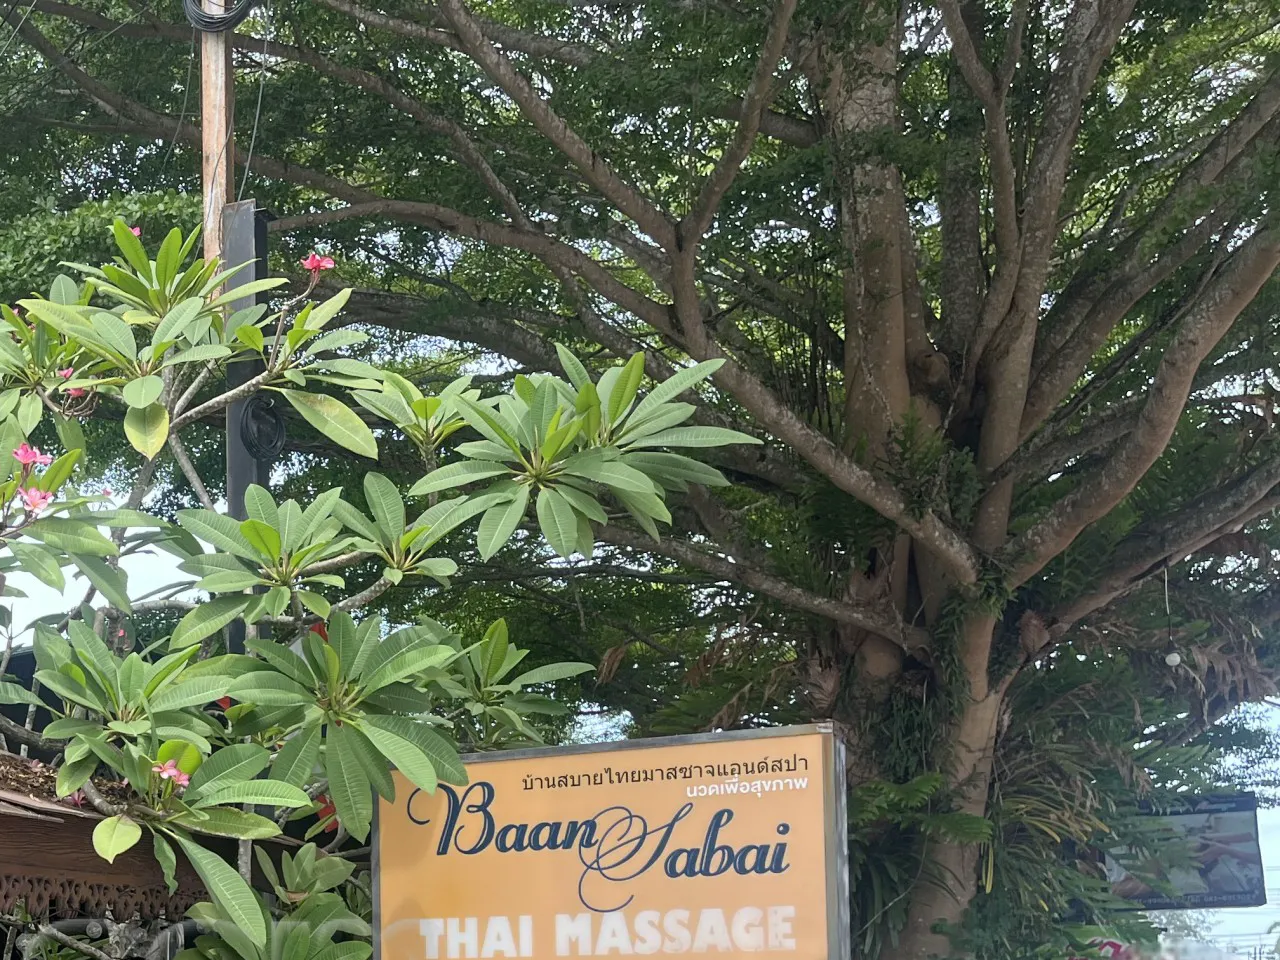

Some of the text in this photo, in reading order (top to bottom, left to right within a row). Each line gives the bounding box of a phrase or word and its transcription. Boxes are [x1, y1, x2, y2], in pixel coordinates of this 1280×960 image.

[686, 774, 808, 799] นวดเพื่อสุขภาพ
[407, 781, 790, 912] Baan Sabai
[421, 905, 796, 960] THAI MASSAGE
